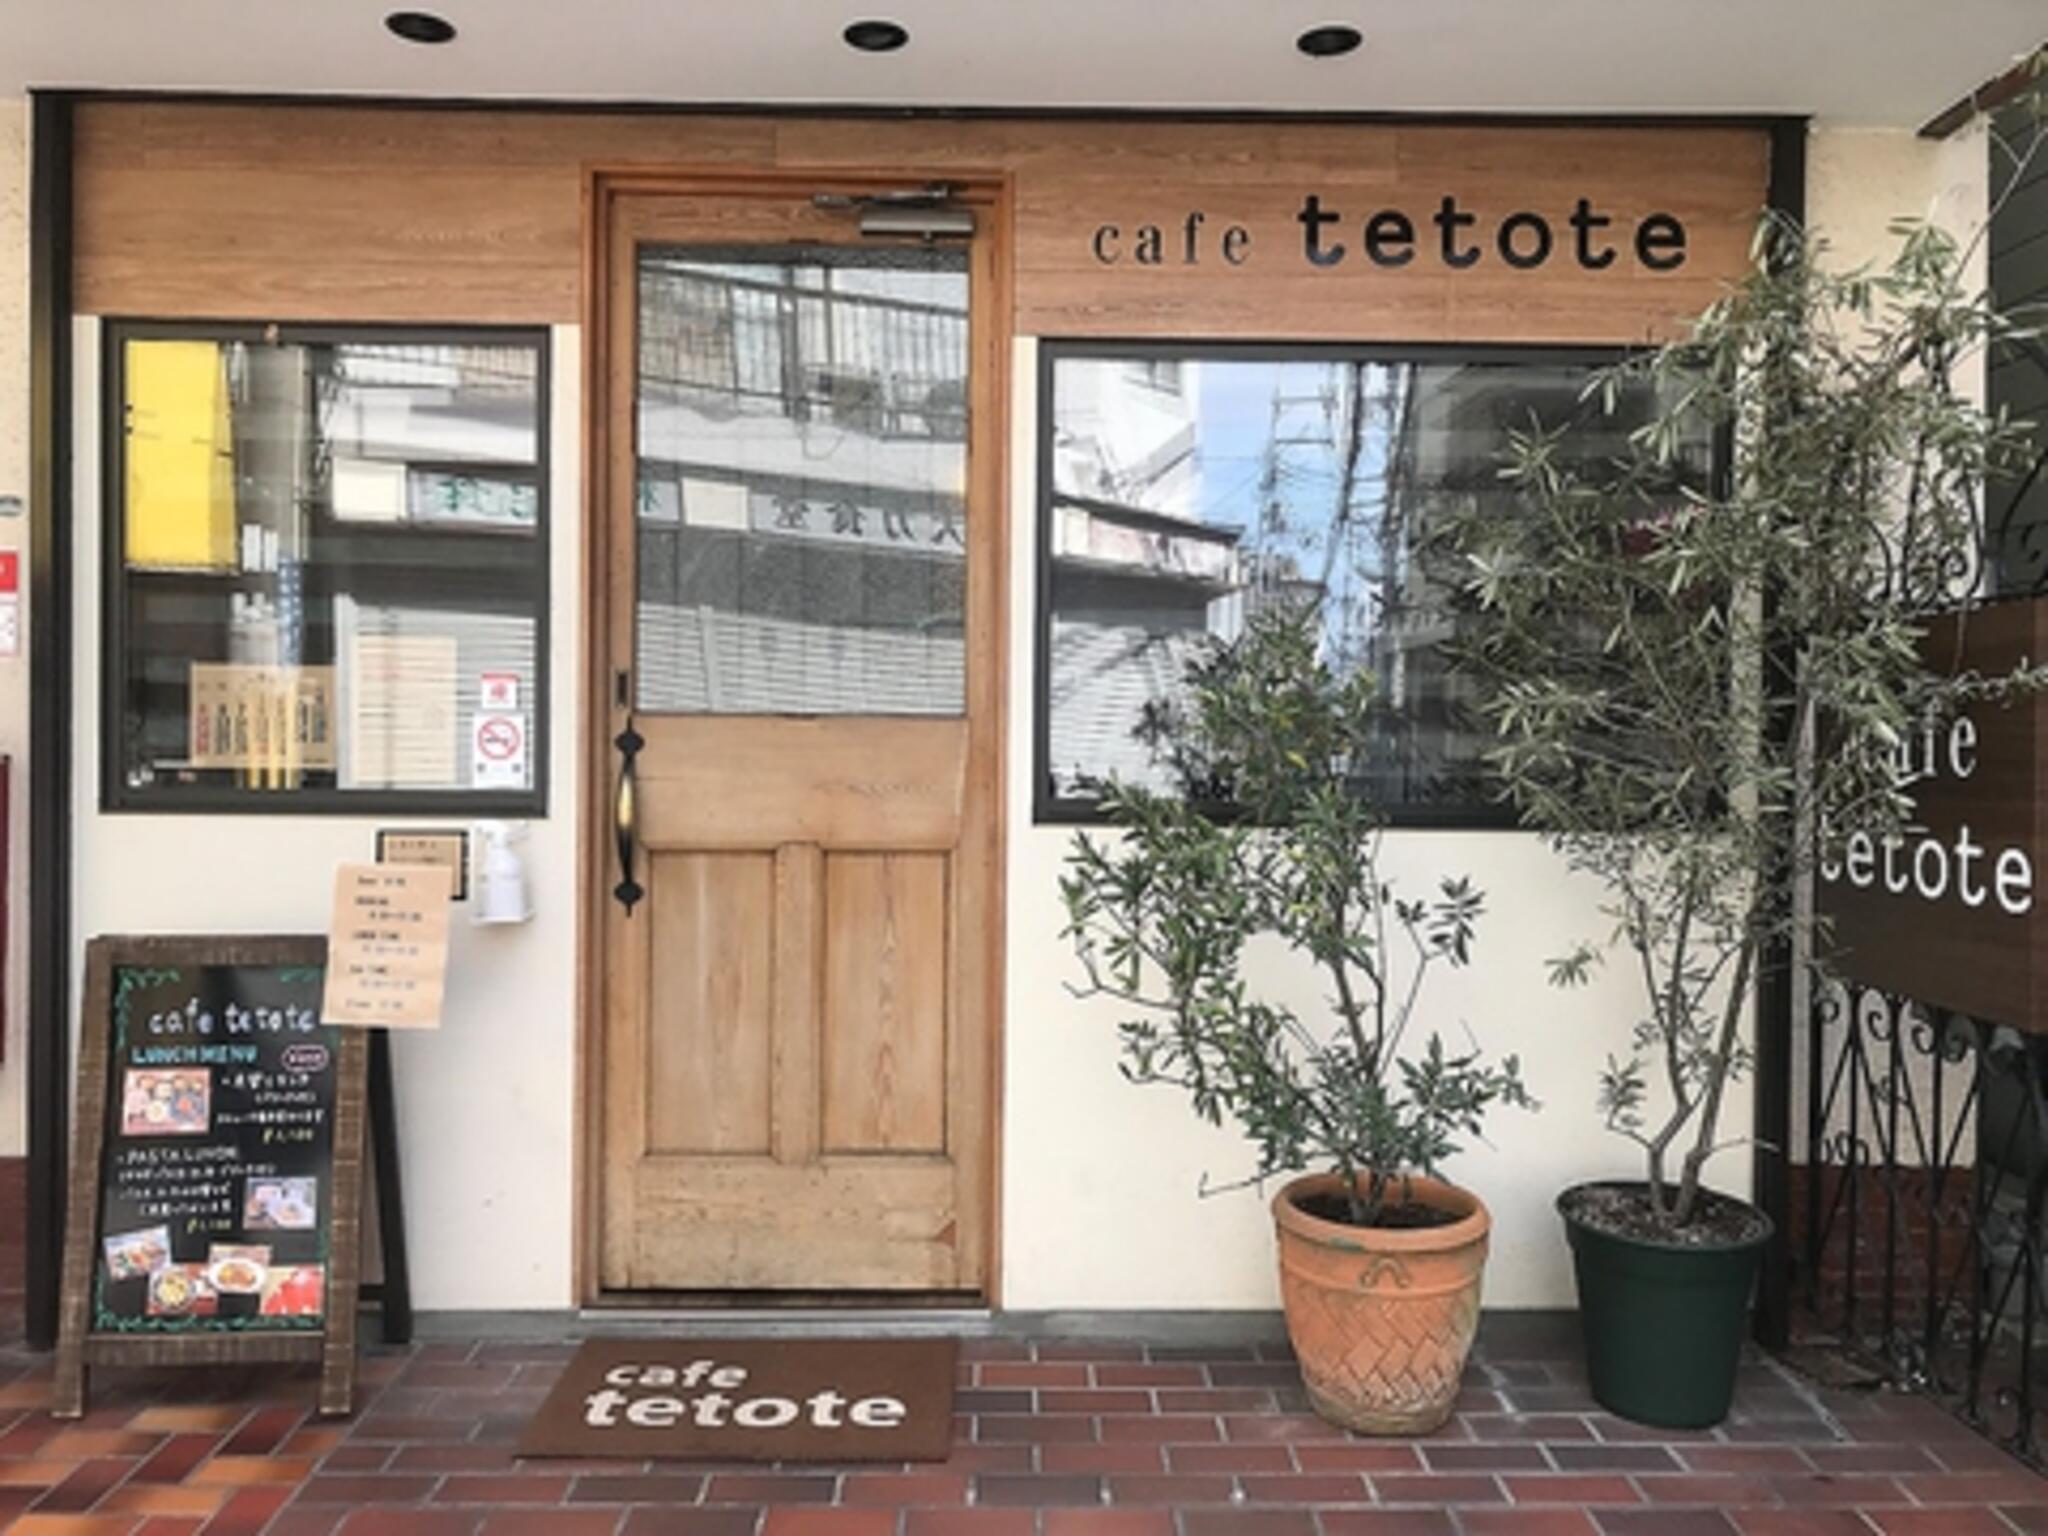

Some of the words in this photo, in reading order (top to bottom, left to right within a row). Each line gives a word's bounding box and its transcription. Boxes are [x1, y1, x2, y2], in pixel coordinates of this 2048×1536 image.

[1092, 212, 1251, 265] cafe
[1297, 195, 1687, 270] tetote
[1820, 812, 2032, 913] tetote
[149, 998, 214, 1033] cafe
[224, 1003, 315, 1032] tetote
[604, 1359, 748, 1388] cafe
[584, 1389, 906, 1427] tetote
